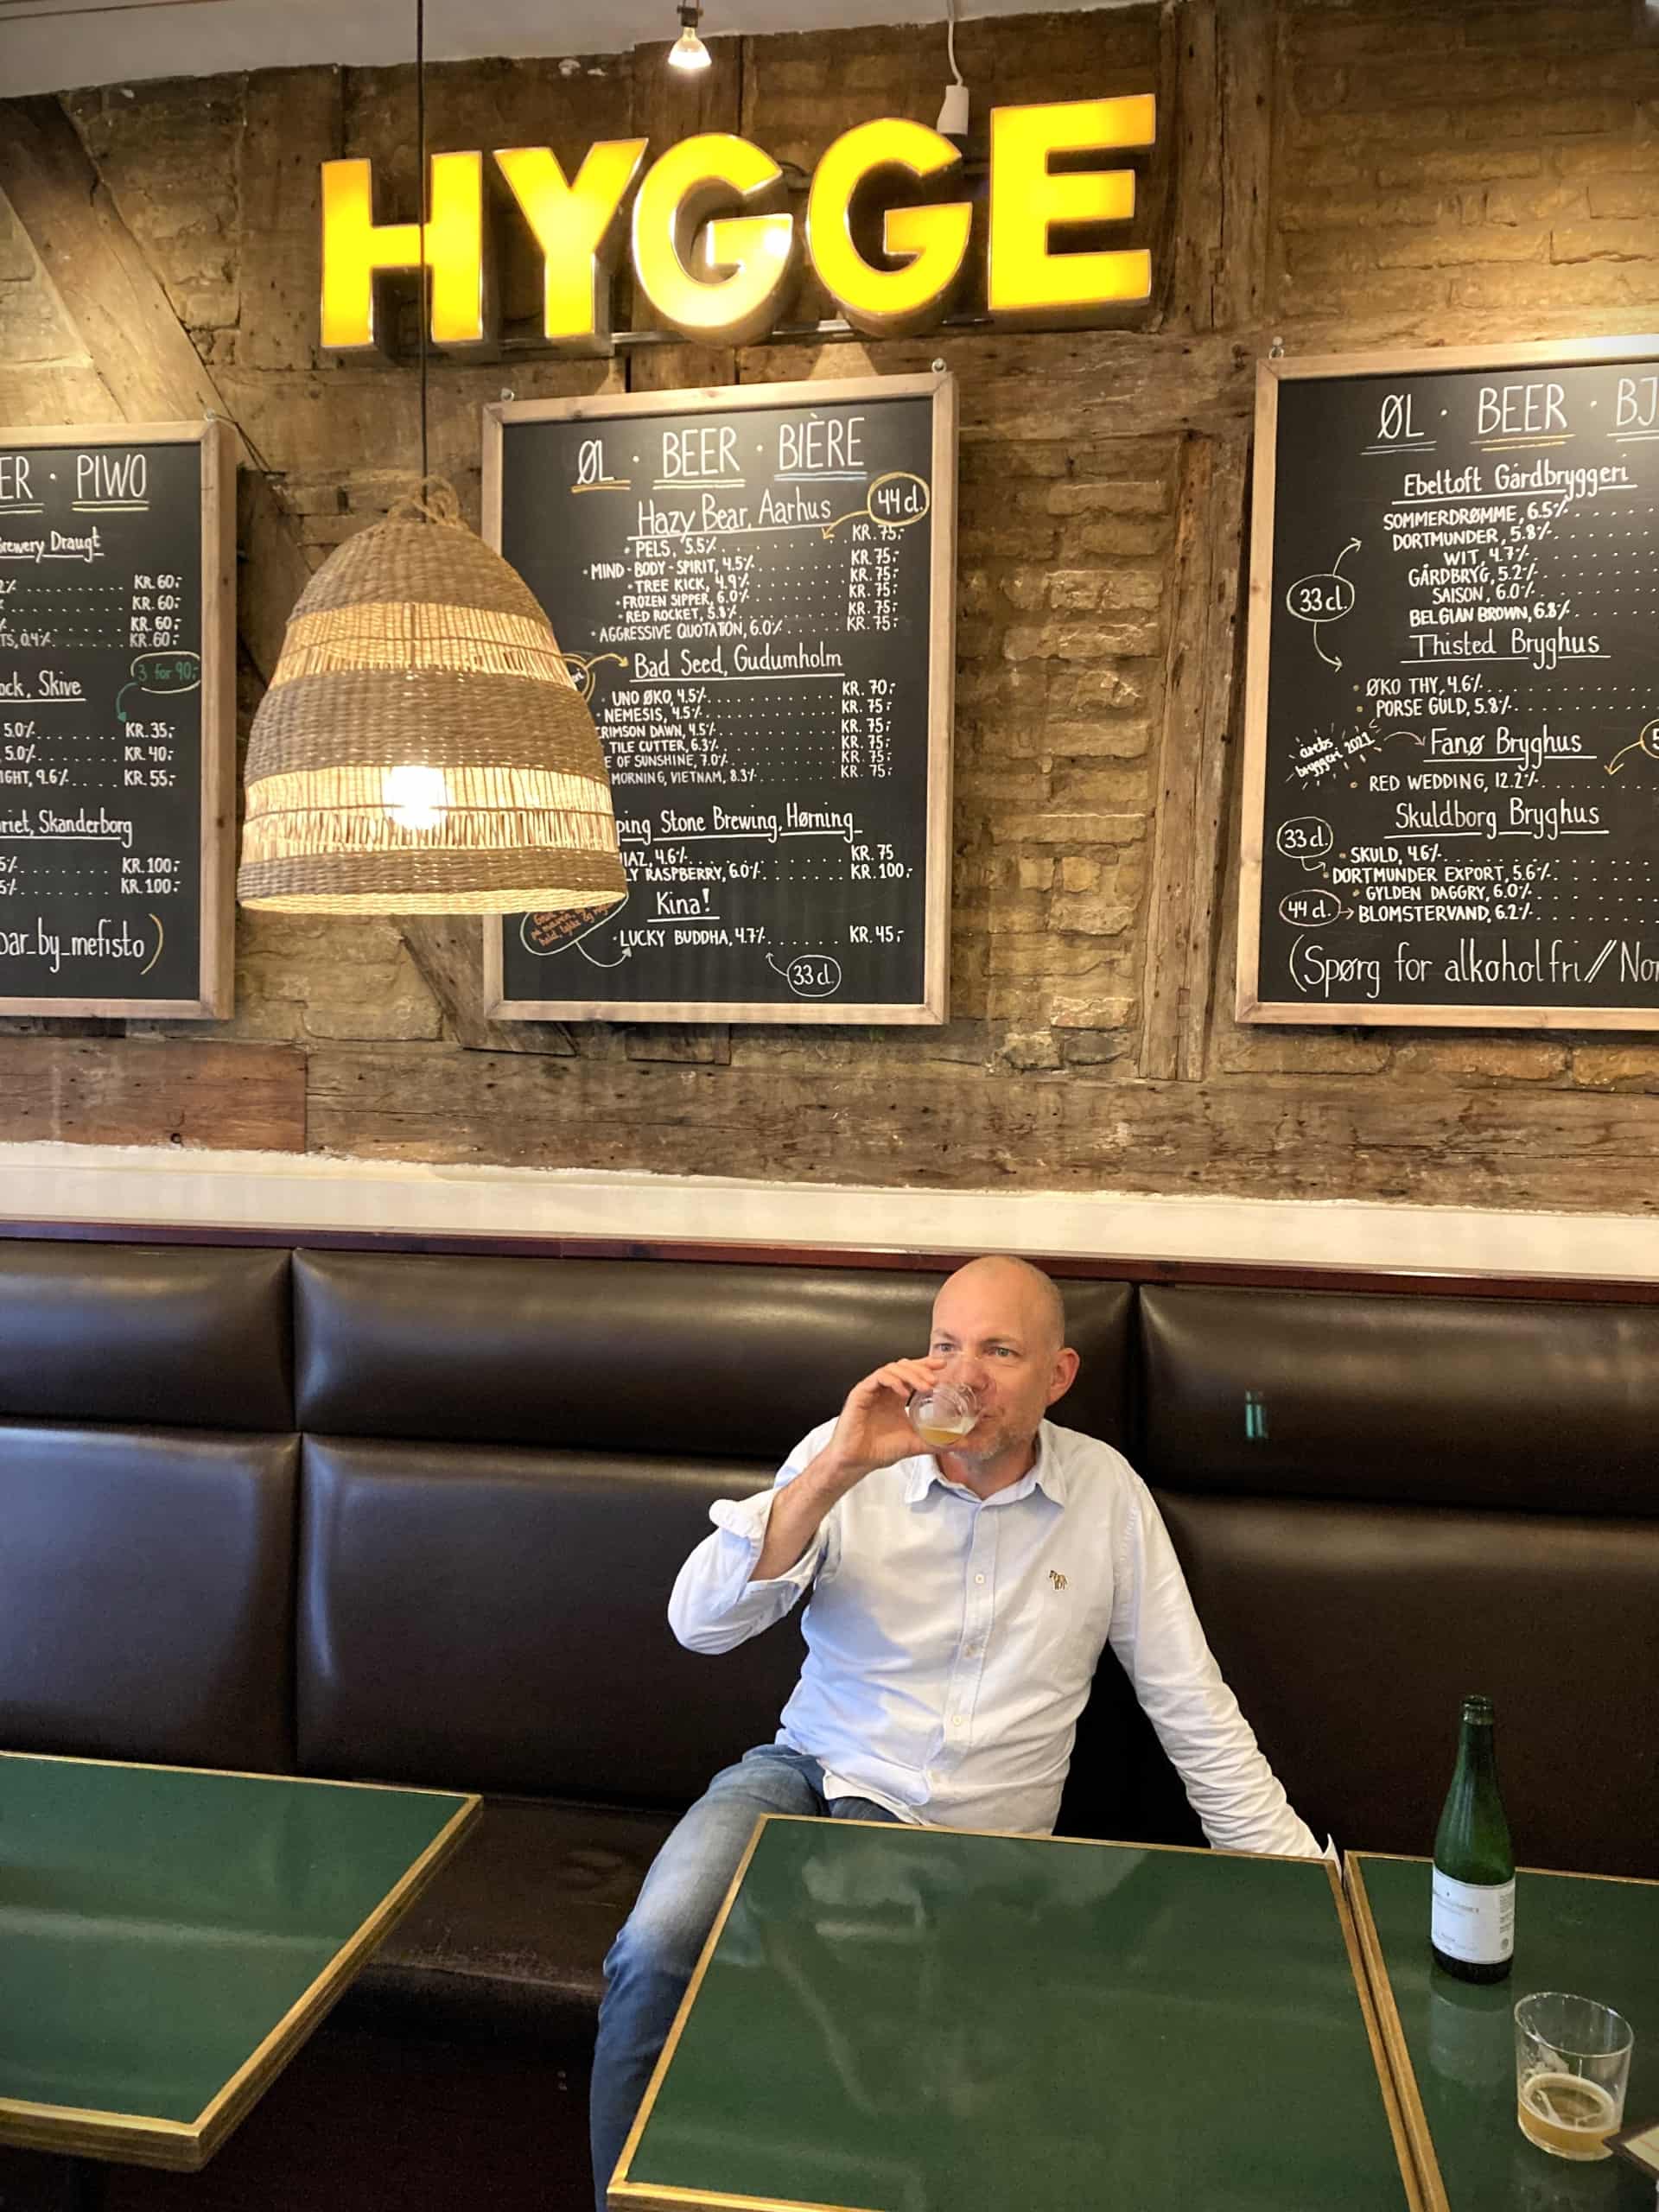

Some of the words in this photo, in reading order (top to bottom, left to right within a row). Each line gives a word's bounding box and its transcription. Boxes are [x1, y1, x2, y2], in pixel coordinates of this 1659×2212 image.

[320, 92, 1156, 348] HYGGE
[1378, 394, 1424, 440] ØL
[1478, 384, 1567, 434] BEER
[1616, 377, 1658, 426] BJ
[577, 439, 615, 484] ØL
[663, 427, 741, 479] BEER
[779, 414, 864, 470] BIÈRE
[77, 454, 148, 499] PIWO
[1404, 467, 1482, 497] Ebeltoft
[1494, 454, 1630, 501] Gårdbryggeri
[878, 486, 900, 515] 44
[639, 499, 696, 543] Hazy
[702, 493, 753, 532] Bear,
[759, 486, 831, 524] Aarhus
[1383, 505, 1524, 531] SOMMERDRØMME,
[1527, 499, 1568, 518] 6.5%
[635, 540, 677, 558] PELS,
[685, 537, 717, 555] 5.5%
[853, 524, 876, 541] KR.
[1393, 528, 1506, 551] DORTMUNDER,
[1510, 521, 1552, 542] 5.8%
[722, 555, 754, 571] 4.5%
[851, 549, 872, 566] KR.
[1444, 549, 1485, 567] WIT,
[634, 580, 670, 594] TREE
[674, 578, 710, 593] KICK,
[715, 573, 750, 589] 4.9%
[850, 567, 872, 582] KR.
[1498, 563, 1538, 582] 5.2%
[622, 595, 667, 610] FROZEN
[671, 593, 714, 608] SIPPER,
[717, 588, 750, 603] 6.0%
[849, 583, 871, 598] KR.
[1300, 589, 1323, 611] 33
[1432, 586, 1491, 605] SAISON,
[1496, 581, 1535, 600] 6.0%
[626, 610, 650, 624] RED
[653, 607, 704, 622] ROCKET,
[849, 601, 871, 615] KR.
[1409, 607, 1475, 627] BELGIAN
[1478, 606, 1532, 623] BROWN,
[1534, 600, 1571, 620] 6.8%
[600, 626, 672, 643] AGGRESSIVE
[750, 620, 783, 636] 6.0%
[847, 616, 870, 632] KR.
[634, 649, 670, 678] Bad
[681, 645, 728, 677] Seed,
[734, 641, 843, 671] Gudumholm
[1409, 629, 1497, 658] Thisted
[1512, 626, 1599, 670] Bryghus
[38, 670, 82, 696] Skive
[155, 664, 171, 679] for
[612, 690, 639, 706] UNO
[677, 687, 707, 703] 4.5%
[842, 681, 864, 696] KR.
[1365, 678, 1402, 696] ØKO
[1408, 677, 1445, 696] THY,
[1447, 673, 1484, 693] 4.6%
[605, 707, 668, 723] NEMESIS,
[672, 706, 702, 721] 4.5%
[842, 699, 862, 714] KR.
[1376, 698, 1423, 718] PORSE
[1428, 696, 1471, 716] GULD,
[1474, 695, 1512, 715] 5.8%
[650, 725, 686, 739] DAWN,
[689, 721, 716, 736] 4.5%
[842, 719, 862, 733] KR.
[609, 741, 635, 753] TILE
[639, 740, 689, 753] CUTTER,
[691, 739, 719, 752] 6.3%
[842, 735, 863, 749] KR.
[1344, 732, 1376, 753] 2021
[1432, 728, 1485, 756] Fanø
[1497, 724, 1582, 771] Bryghus
[617, 755, 632, 768] OF
[635, 754, 697, 768] SUNSHINE,
[701, 753, 728, 766] 7.0%
[842, 750, 864, 763] KR.
[671, 772, 727, 785] VIETNAM,
[841, 765, 863, 778] KR.
[1370, 775, 1401, 791] RED
[1408, 772, 1488, 793] WEDDING,
[1496, 772, 1539, 788] 12.2%
[39, 807, 132, 849] Skanderborg
[661, 809, 706, 834] Stone
[713, 804, 783, 843] Brewing,
[786, 802, 854, 843] Hørning
[1395, 799, 1497, 840] Skuldborg
[1510, 797, 1599, 841] Bryghus
[1284, 828, 1307, 849] 33
[655, 846, 688, 865] 4.6%
[850, 845, 874, 861] KR.
[877, 843, 894, 861] 75
[1351, 846, 1402, 865] SKULD,
[645, 868, 726, 883] RASPBERRY,
[850, 864, 875, 880] KR.
[1332, 867, 1438, 884] DORTMUNDER
[1445, 866, 1509, 883] EXPORT,
[1513, 862, 1551, 880] 5.6%
[657, 888, 710, 915] Kina!
[1365, 886, 1421, 901] GYLDEN
[1430, 885, 1490, 902] DAGGRY,
[1493, 882, 1533, 899] 6.0%
[1287, 899, 1308, 918] 44
[1358, 906, 1492, 924] BLOMSTERVAND,
[1495, 902, 1533, 921] 6.2%
[620, 930, 665, 947] LUCKY
[675, 928, 733, 947] BUDDHA,
[849, 925, 873, 943] KR.
[1395, 942, 1433, 982] for
[793, 964, 814, 985] 33
